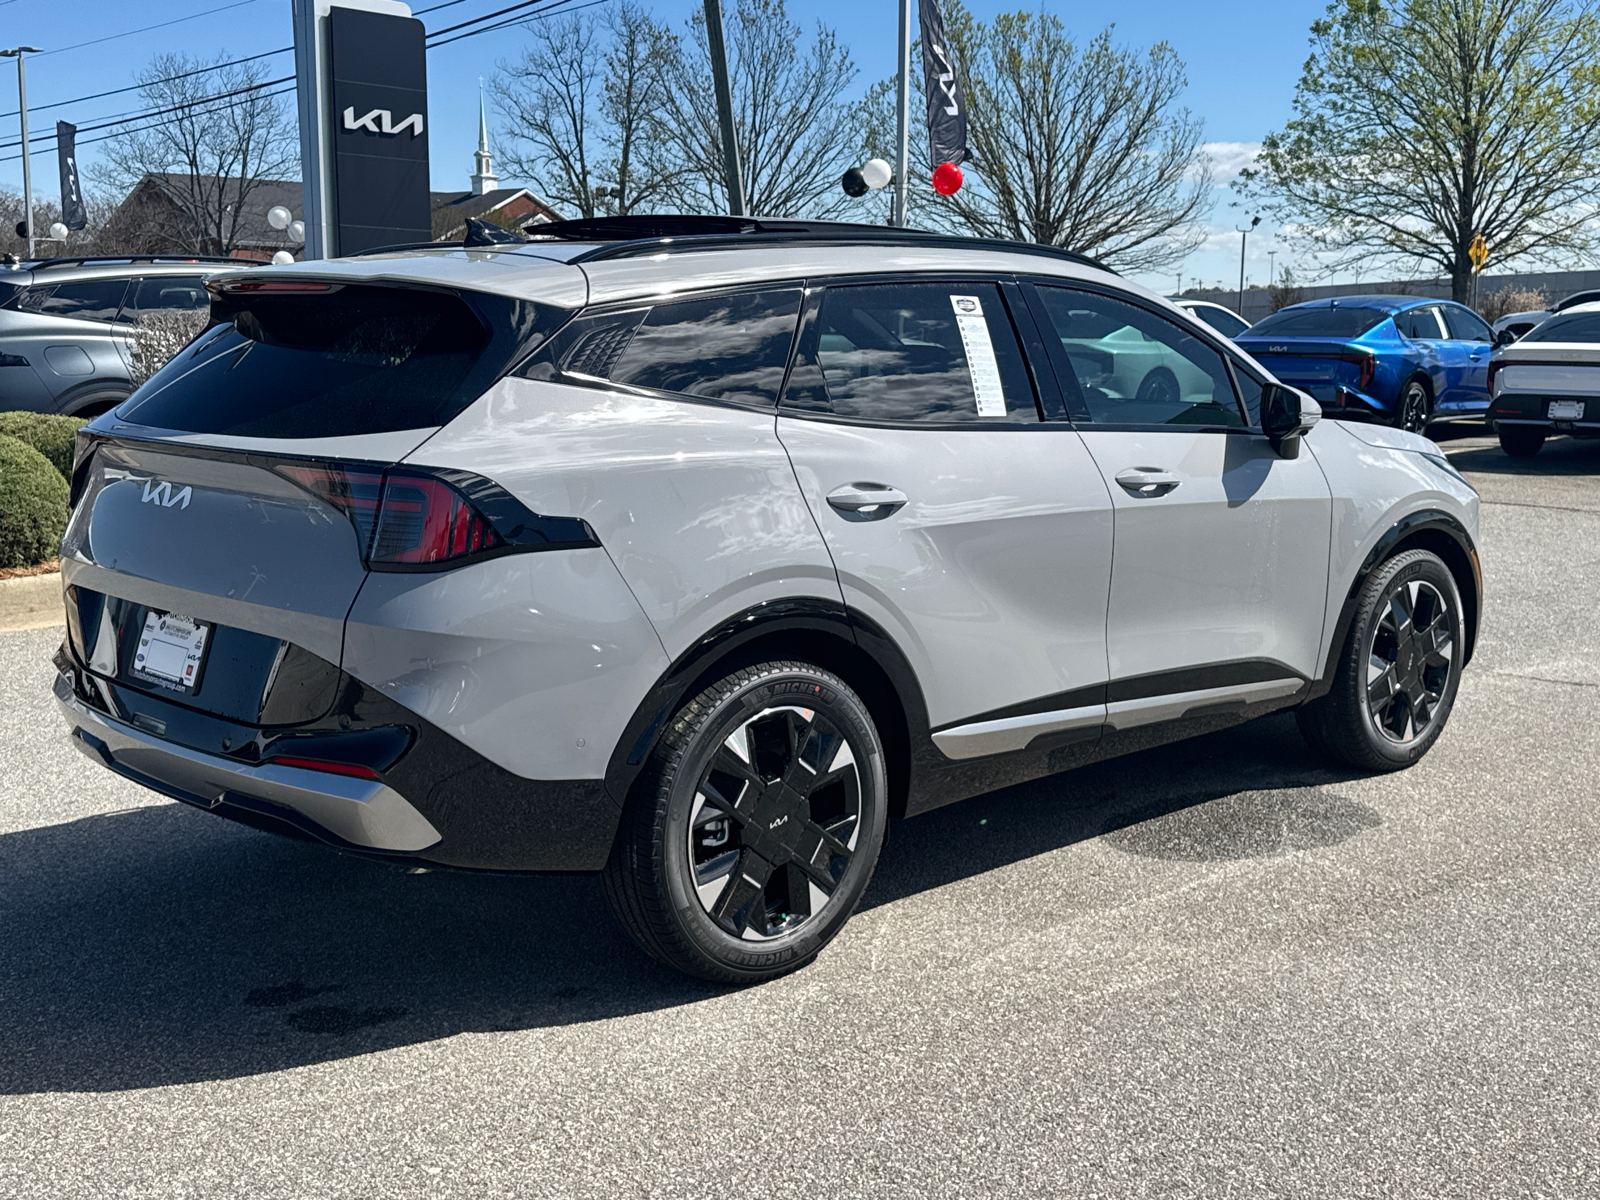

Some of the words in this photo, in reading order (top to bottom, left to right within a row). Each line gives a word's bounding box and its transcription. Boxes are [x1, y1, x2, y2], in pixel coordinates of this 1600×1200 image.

[343, 106, 423, 136] KIA
[142, 479, 193, 511] KIA
[187, 653, 201, 662] KIA
[773, 682, 837, 704] MICHELIN
[769, 815, 788, 830] KIA
[725, 949, 793, 967] MICHELIN
